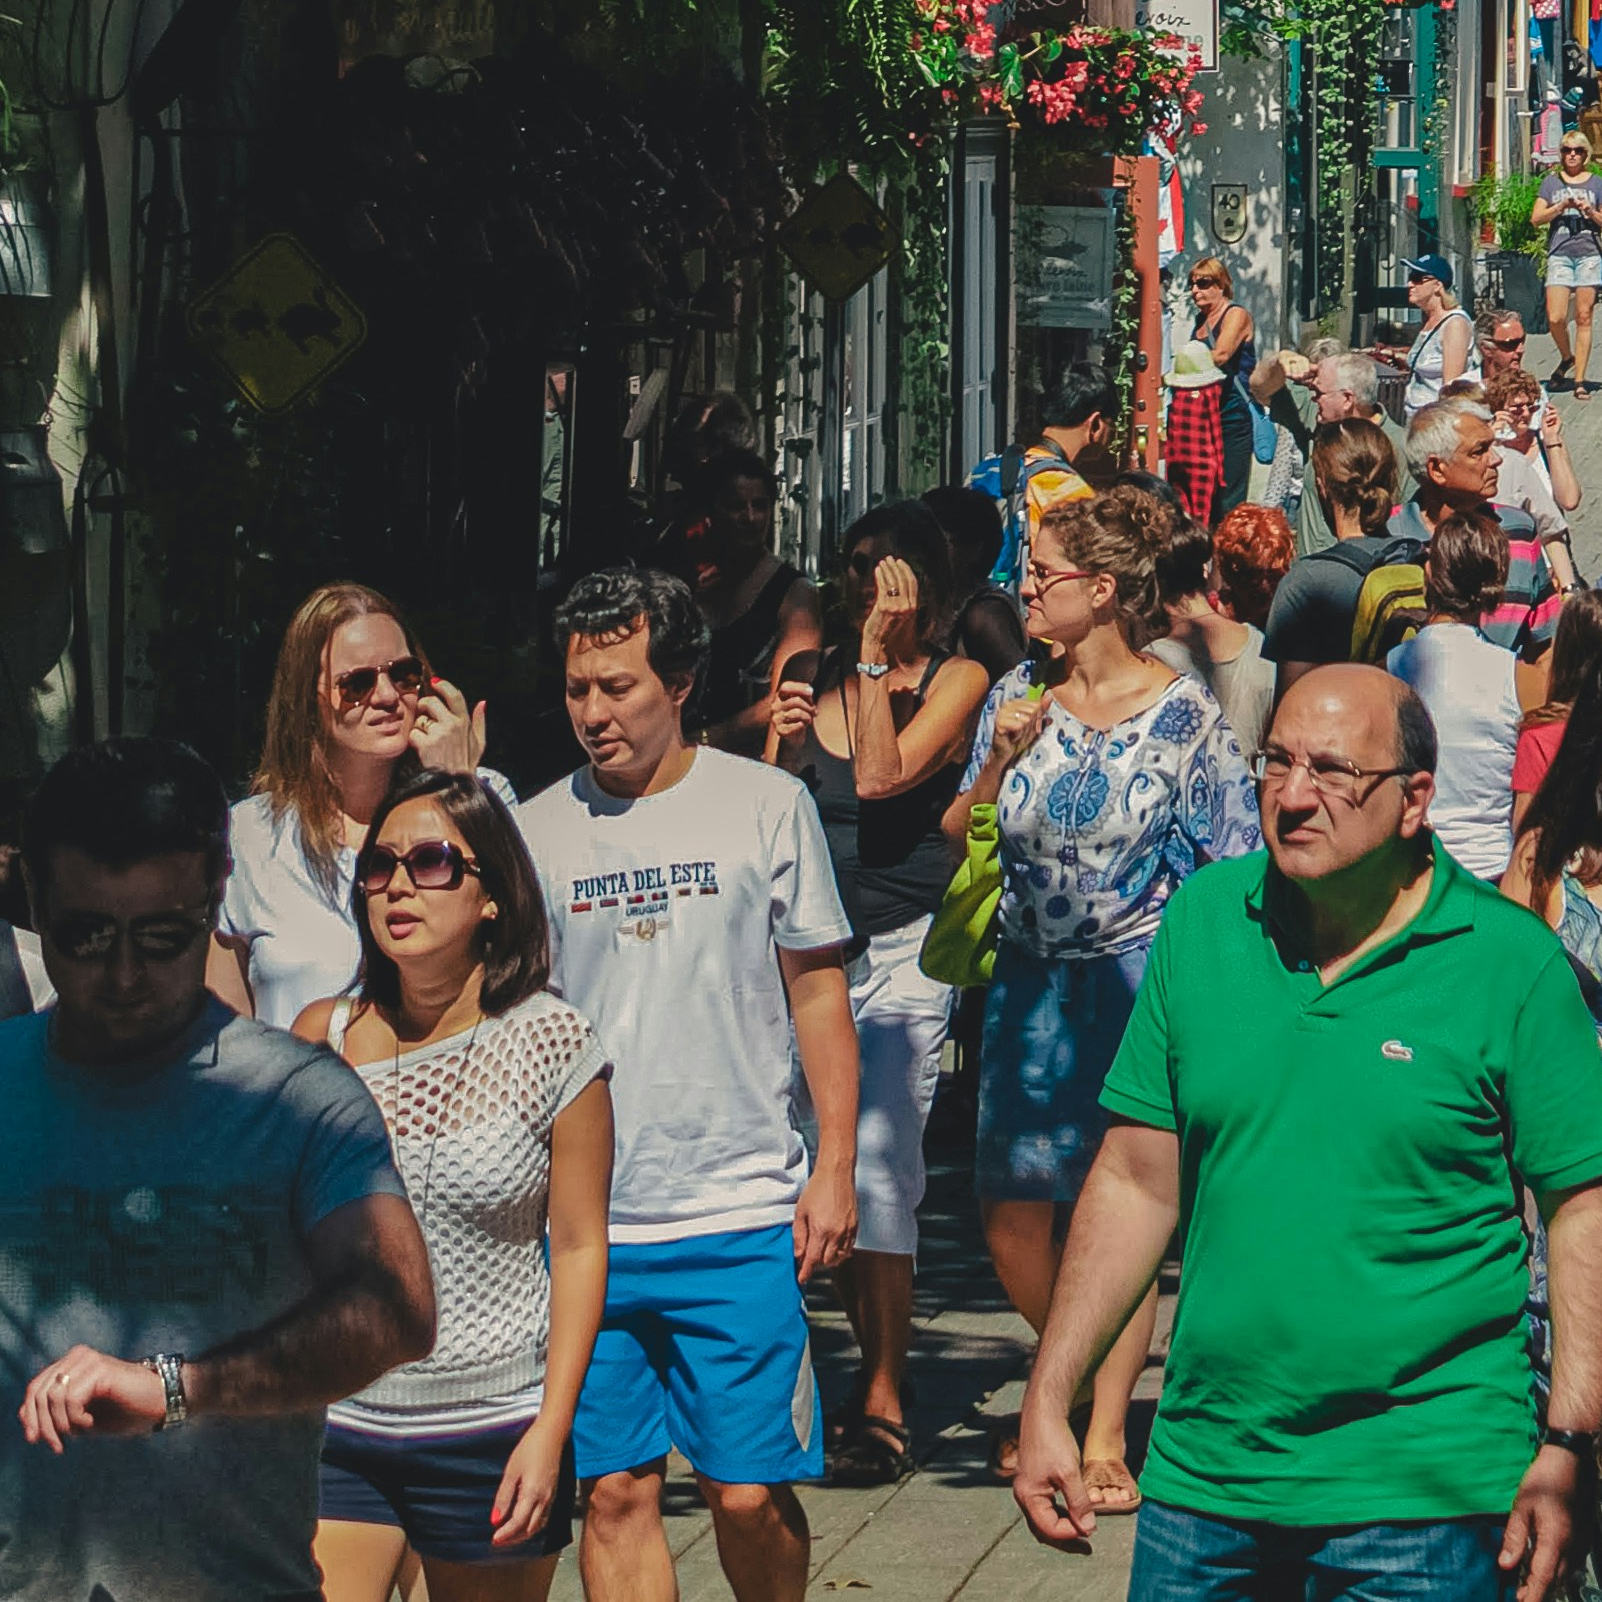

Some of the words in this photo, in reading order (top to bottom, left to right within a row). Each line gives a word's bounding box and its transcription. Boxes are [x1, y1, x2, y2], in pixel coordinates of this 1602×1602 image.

[1136, 5, 1191, 27] evoix
[1219, 193, 1240, 211] 40
[573, 872, 629, 900] PUNTA
[633, 867, 666, 891] DEL
[669, 861, 715, 885] ESTE
[626, 902, 669, 917] URUGUAY
